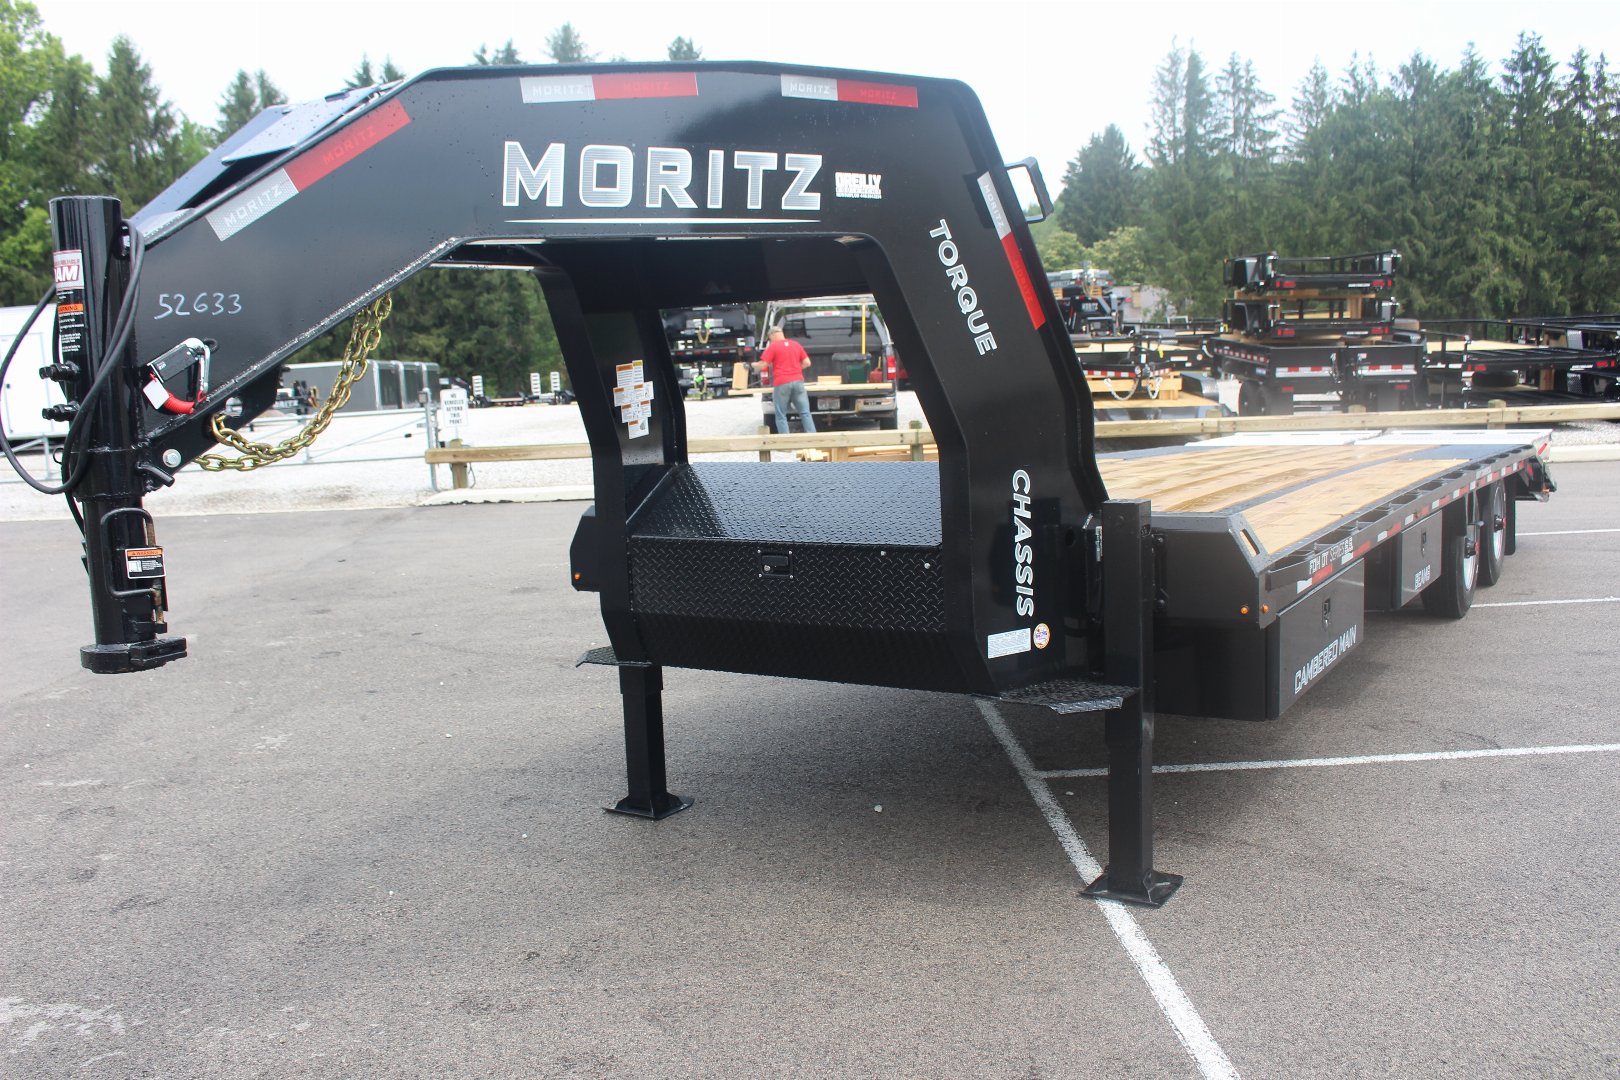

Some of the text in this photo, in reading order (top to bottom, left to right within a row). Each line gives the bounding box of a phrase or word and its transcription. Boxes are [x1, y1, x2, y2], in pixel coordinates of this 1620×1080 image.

[531, 84, 586, 97] MORITZ
[789, 81, 831, 95] MORITZ
[502, 140, 823, 211] MORITZ
[223, 182, 284, 229] MORITZ
[983, 184, 1005, 228] MORITZ
[154, 292, 243, 320] 52633
[929, 219, 998, 356] TORQUE
[1012, 469, 1034, 617] CHASSIS
[1295, 624, 1357, 694] CAMBERED MAIN
